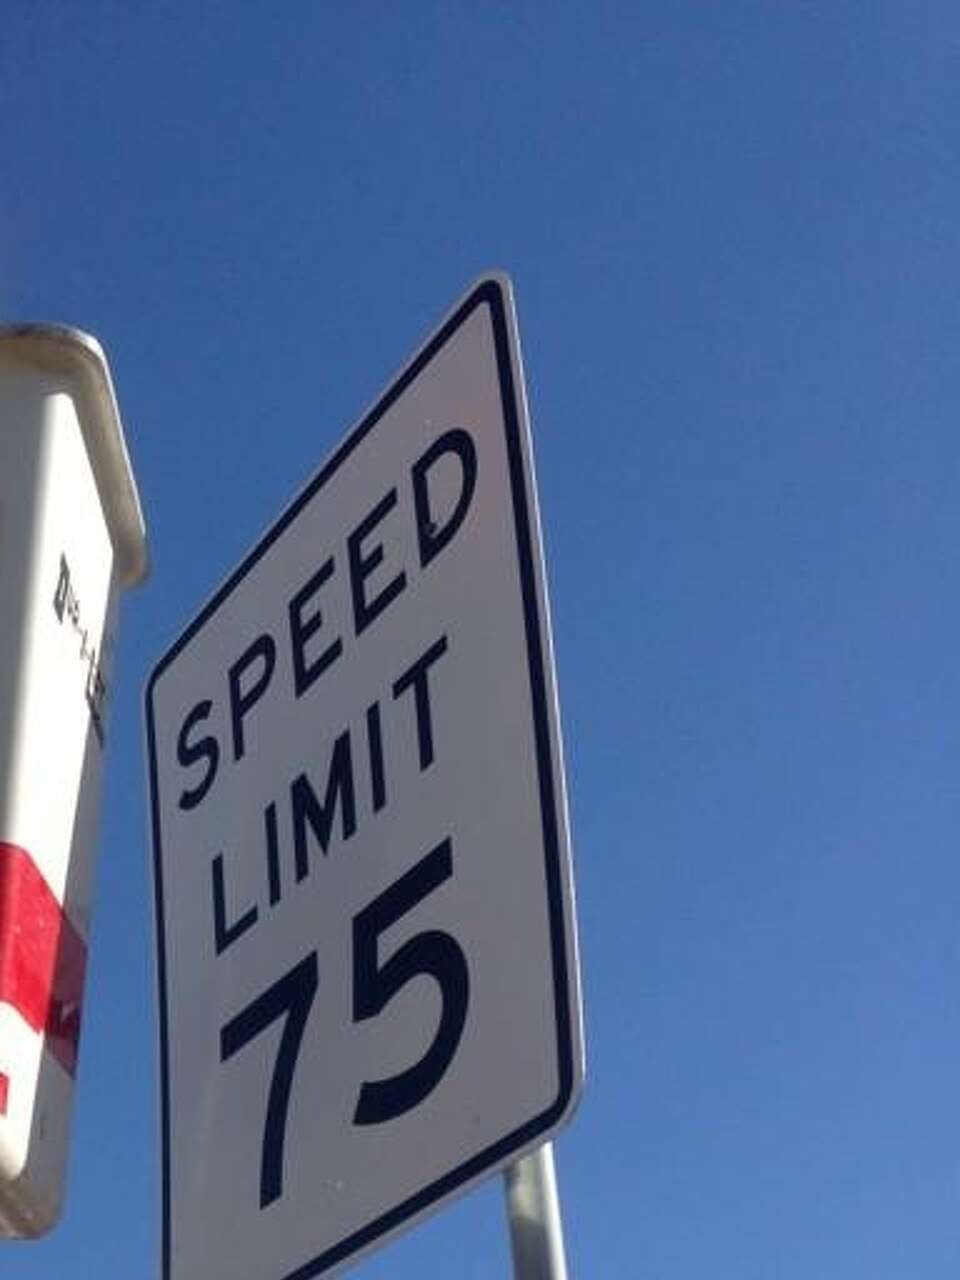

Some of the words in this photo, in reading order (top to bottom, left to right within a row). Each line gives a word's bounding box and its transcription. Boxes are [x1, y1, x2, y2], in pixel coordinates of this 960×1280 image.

[176, 427, 478, 811] SPEED
[211, 634, 449, 957] LIMIT
[219, 836, 471, 1211] 75
